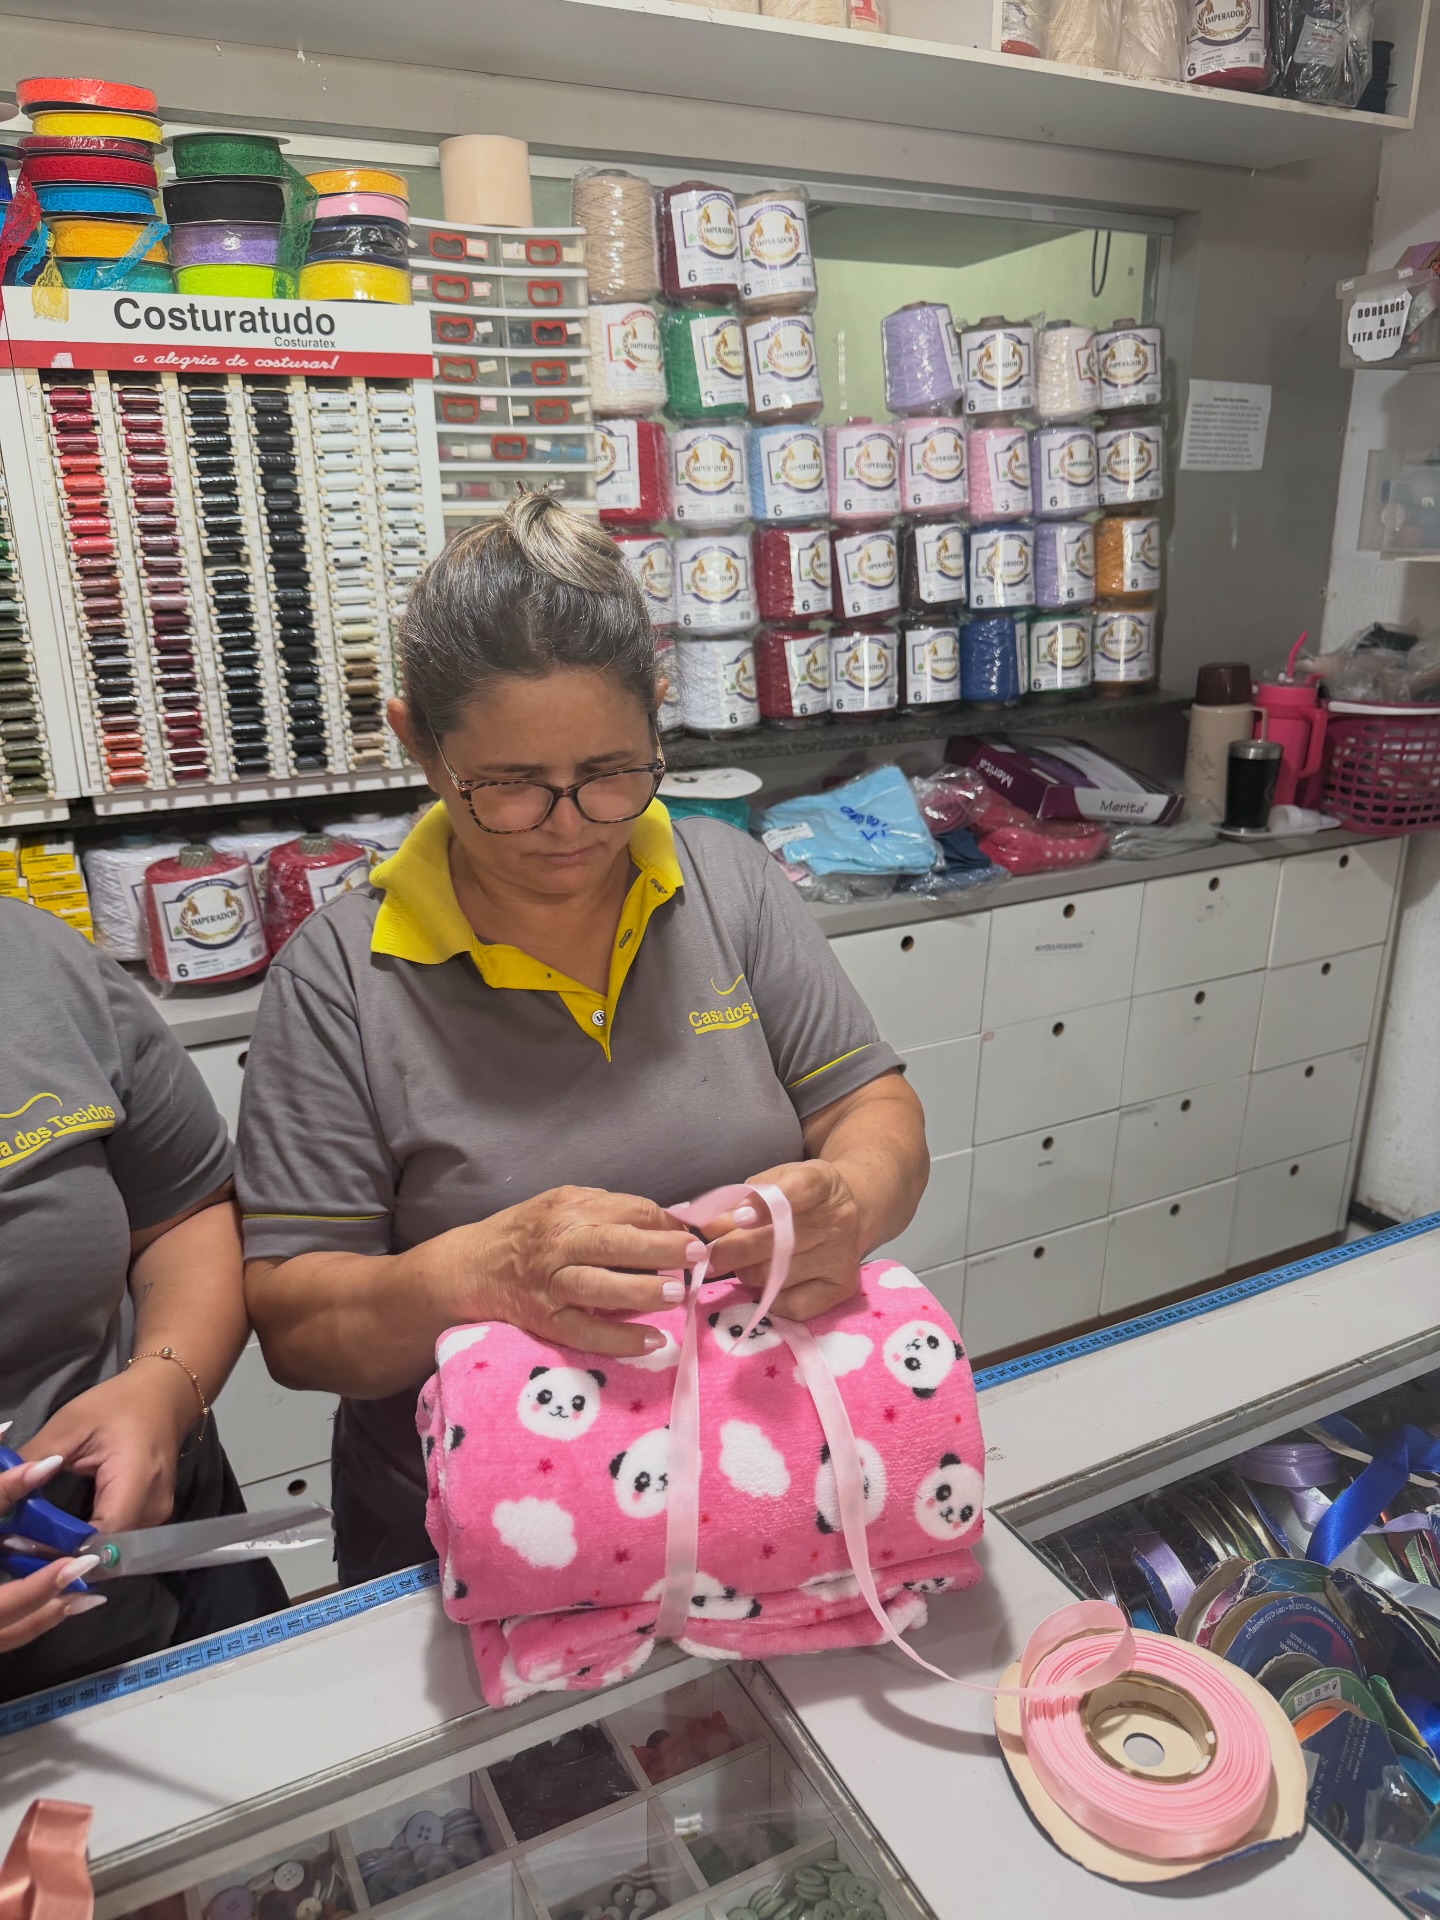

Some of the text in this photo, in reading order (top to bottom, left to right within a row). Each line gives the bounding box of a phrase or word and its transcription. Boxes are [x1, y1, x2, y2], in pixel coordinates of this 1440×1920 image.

[1205, 10, 1244, 24] IMPERADOR
[1187, 63, 1196, 76] 6
[687, 270, 697, 282] 6
[743, 283, 752, 296] 6
[1357, 300, 1405, 319] BORDADOS
[114, 298, 336, 336] Costuratudo
[274, 336, 336, 349] Costuratex
[1352, 332, 1372, 343] FITA
[133, 351, 339, 370] a alegria de costurar!
[762, 394, 771, 407] 6
[967, 400, 976, 412] 6
[844, 499, 852, 511] 6
[913, 493, 921, 505] 6
[1050, 497, 1057, 507] 6
[677, 505, 685, 517] 6
[774, 504, 782, 517] 6
[1131, 579, 1138, 589] 6
[1067, 588, 1074, 599] 6
[802, 600, 810, 611] 6
[976, 596, 984, 606] 6
[853, 602, 861, 613] 6
[683, 614, 691, 626] 6
[1033, 679, 1041, 690] 6
[914, 692, 921, 702] 6
[800, 704, 808, 715] 6
[836, 699, 843, 710] 6
[730, 712, 738, 724] 6
[981, 759, 1014, 788] Merita
[1100, 801, 1145, 815] Merita
[191, 909, 237, 926] IMPERADOR
[177, 964, 189, 978] 6
[725, 1002, 752, 1022] dos
[14, 1131, 52, 1150] dos
[46, 1104, 116, 1129] Tecidos
